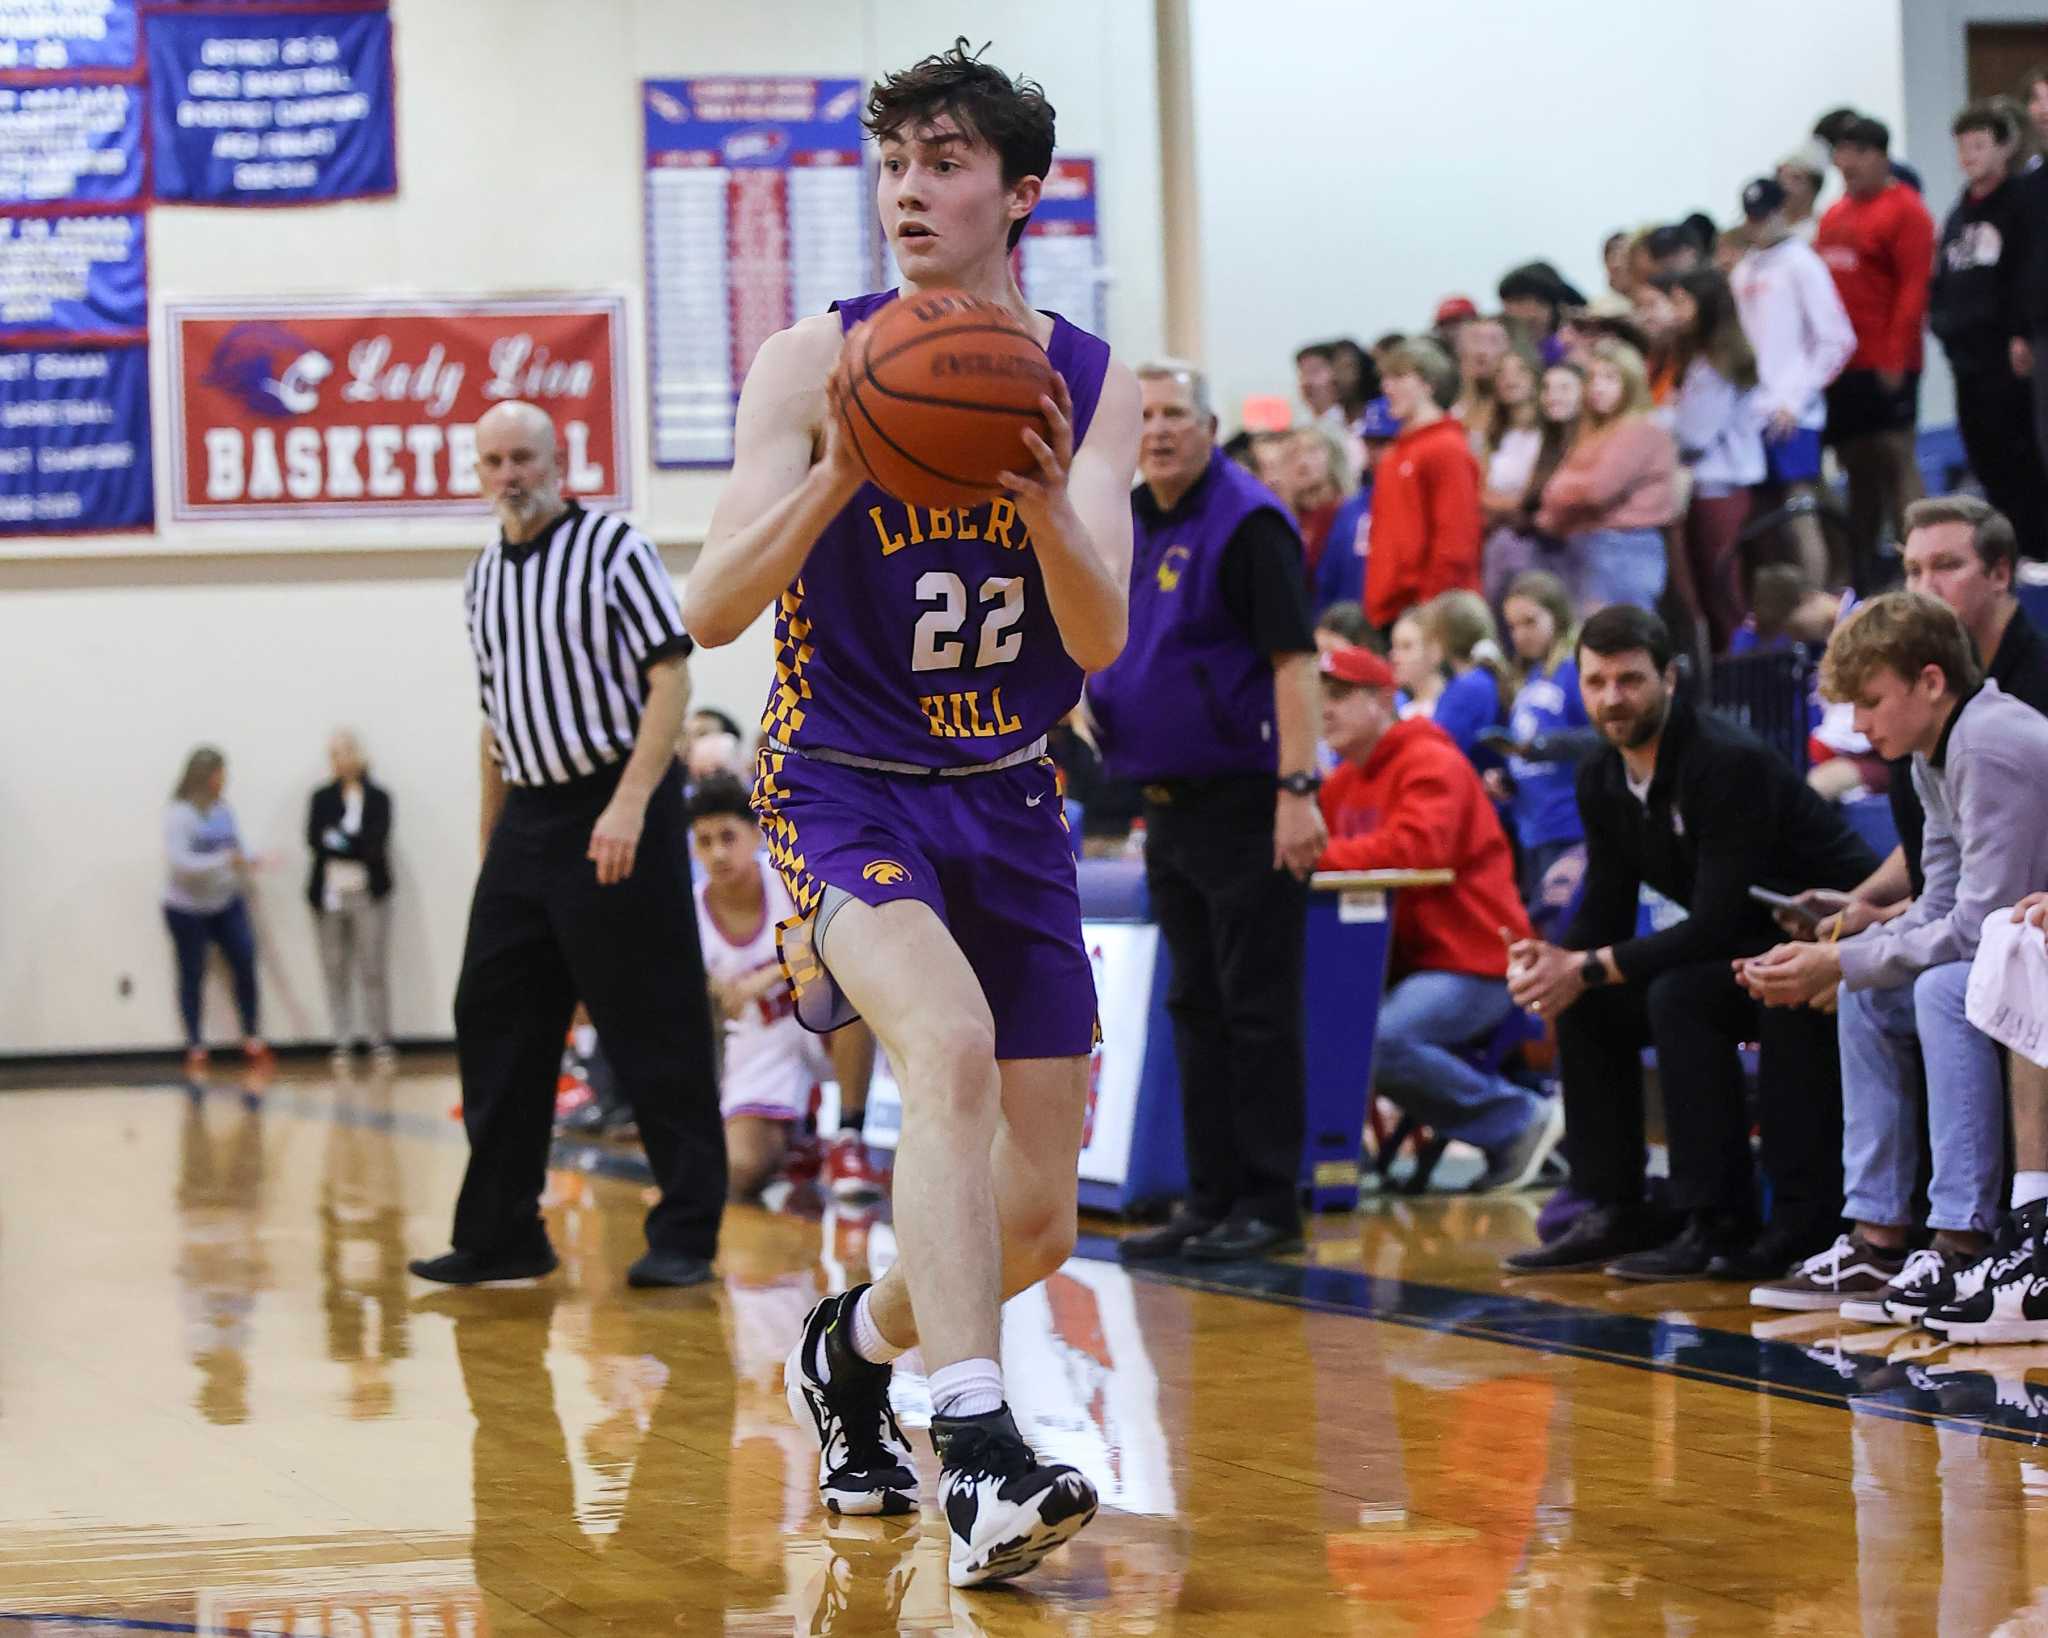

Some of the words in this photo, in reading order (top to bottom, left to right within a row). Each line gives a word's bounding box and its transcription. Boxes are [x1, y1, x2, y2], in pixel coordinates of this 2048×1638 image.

[341, 335, 464, 418] Lady
[482, 333, 595, 400] Lion
[204, 420, 602, 500] BASKETBL
[868, 497, 1028, 557] LIBER
[911, 571, 1025, 672] 22
[919, 686, 1023, 738] HILL
